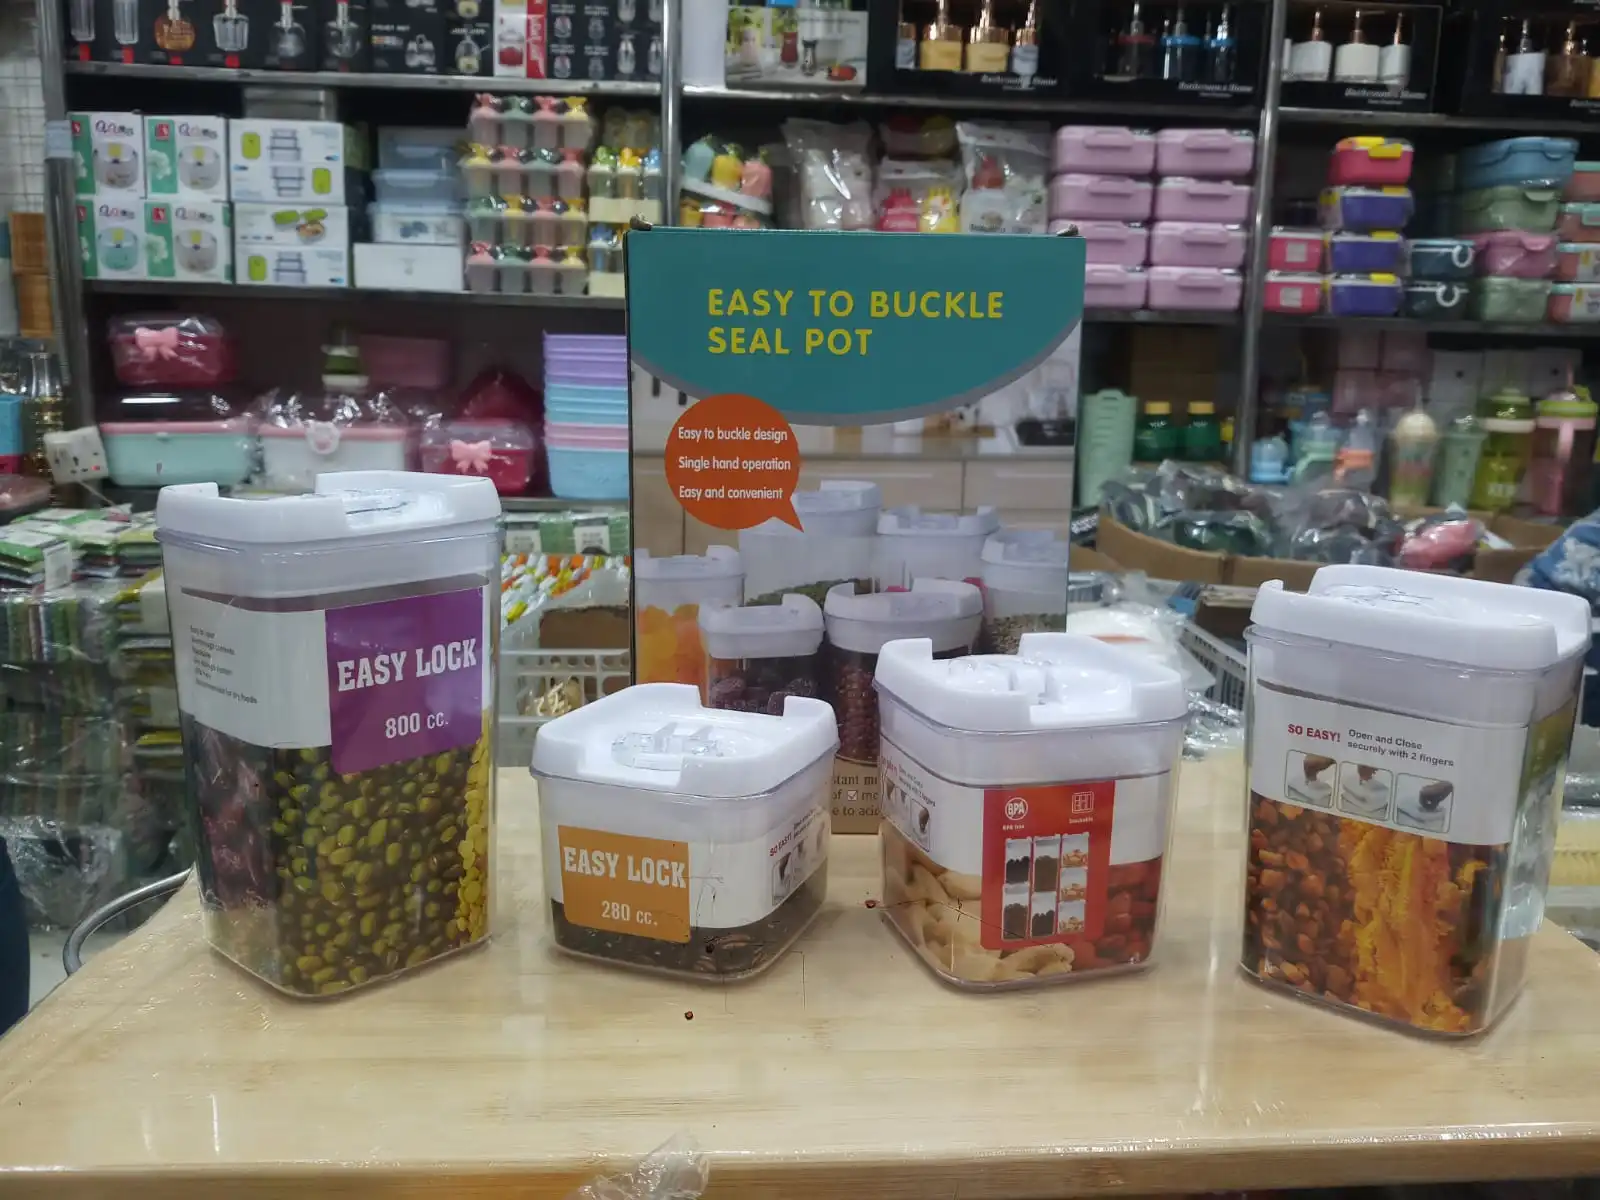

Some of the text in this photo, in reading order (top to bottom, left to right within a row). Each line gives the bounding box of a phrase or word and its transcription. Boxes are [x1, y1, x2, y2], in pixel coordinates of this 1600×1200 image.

[707, 288, 1005, 319] EASY TO BUCKLE
[708, 326, 874, 356] SEAL POT
[678, 427, 788, 444] Easy to buckle design
[678, 456, 791, 472] Single hand operation
[679, 485, 784, 502] Easy and convenient
[337, 638, 477, 692] EASY LOCK
[385, 712, 421, 739] 800
[1287, 723, 1341, 743] SO EASY!
[1348, 728, 1423, 750] Open and Close
[1347, 740, 1455, 767] securely with 2 fingers
[842, 806, 855, 816] to
[1007, 801, 1025, 818] BPA
[563, 846, 687, 889] EASY LOCK
[601, 900, 631, 922] 280
